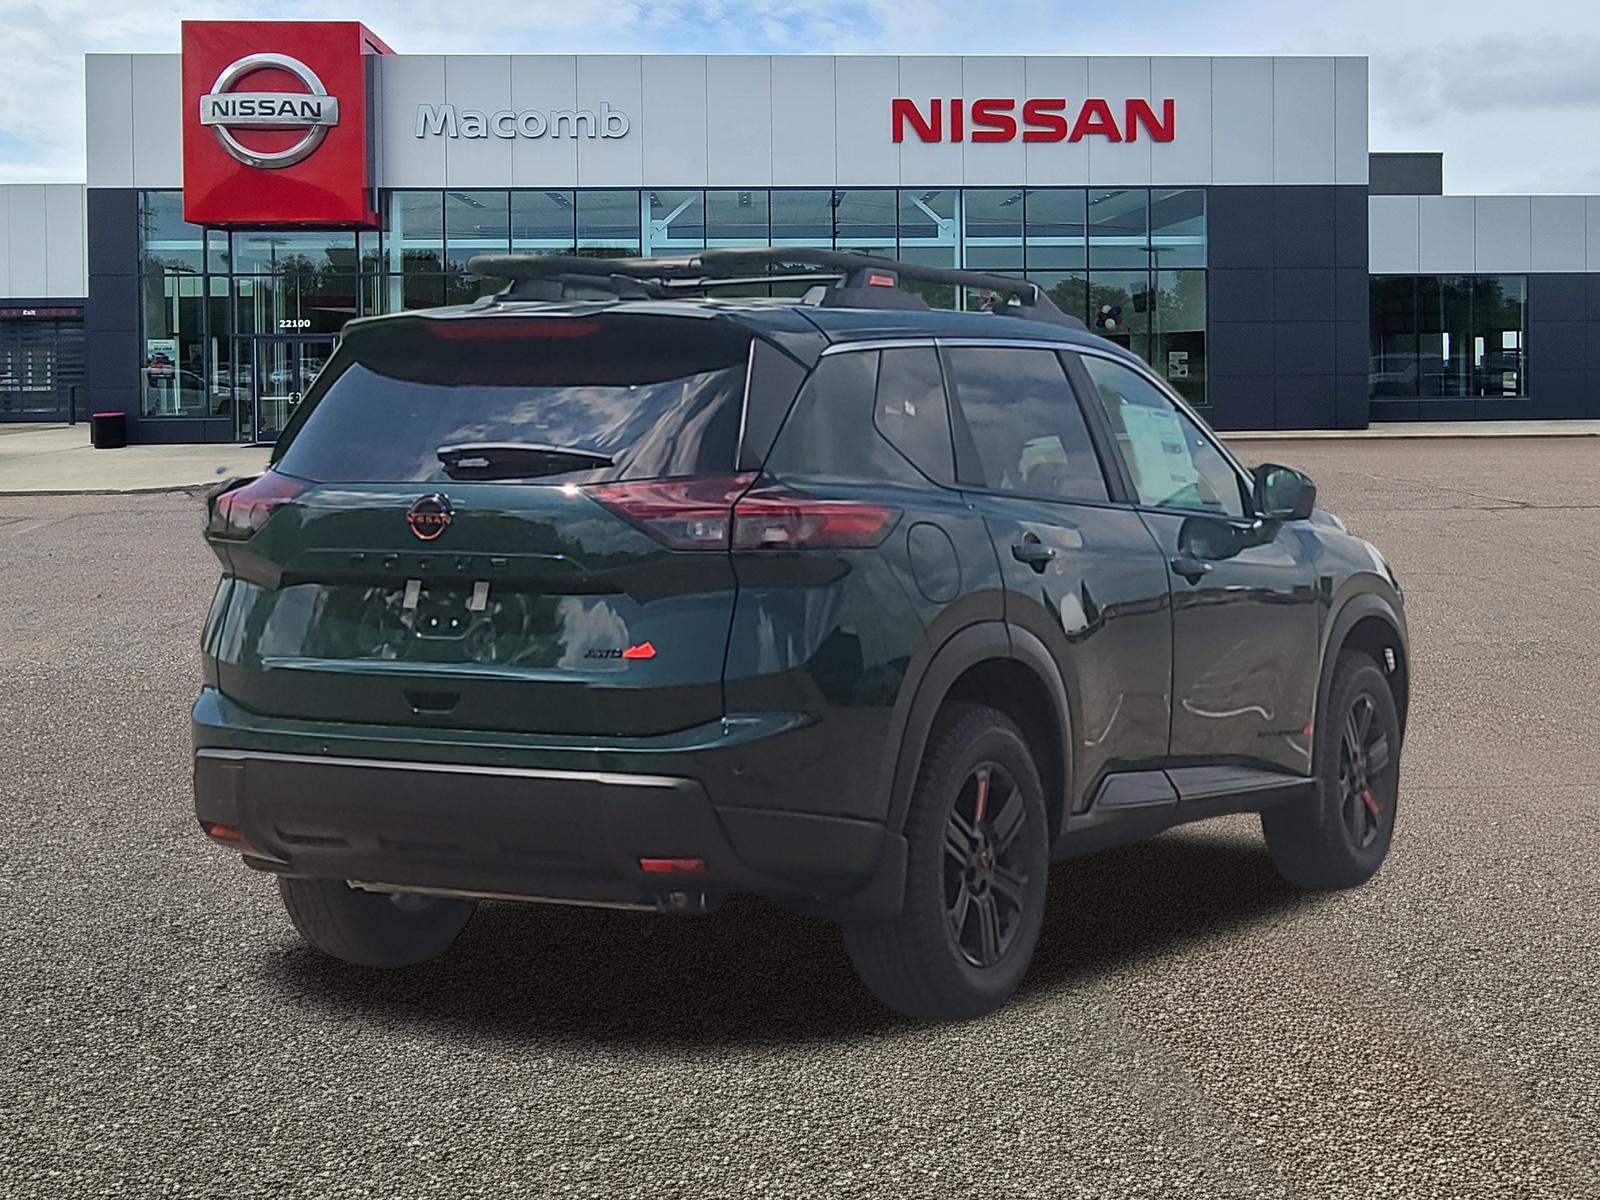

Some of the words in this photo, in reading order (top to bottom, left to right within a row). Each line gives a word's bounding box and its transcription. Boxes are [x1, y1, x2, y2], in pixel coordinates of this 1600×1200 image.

[211, 100, 322, 118] NISSAN
[415, 101, 630, 139] Macomb
[892, 98, 1176, 143] NISSAN
[279, 319, 311, 328] 22100
